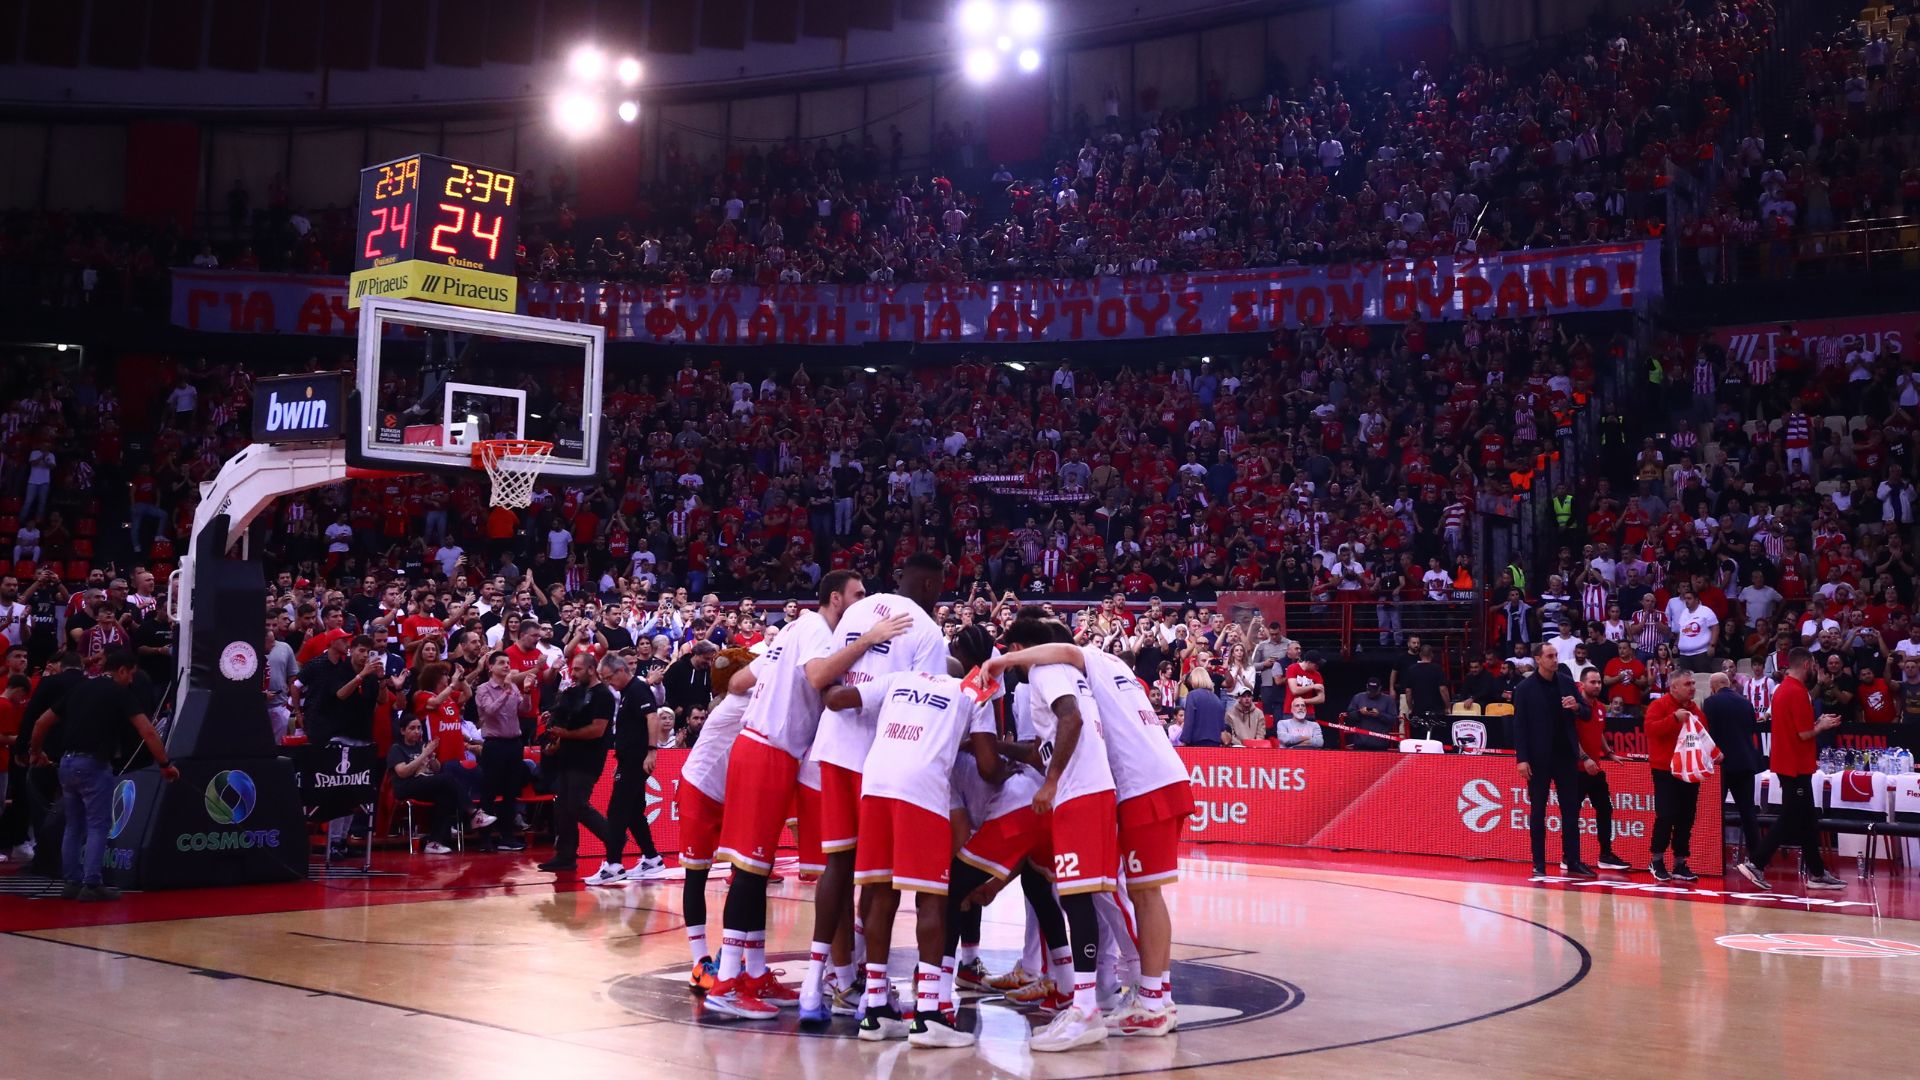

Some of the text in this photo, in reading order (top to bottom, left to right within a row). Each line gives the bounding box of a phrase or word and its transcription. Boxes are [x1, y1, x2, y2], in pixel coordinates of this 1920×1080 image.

[376, 159, 419, 200] 2:39
[445, 164, 515, 206] 2:39
[365, 203, 411, 258] 24
[430, 203, 502, 260] 24
[448, 256, 484, 270] Quince
[369, 275, 409, 295] Piraeus
[444, 277, 509, 302] Piraeus
[984, 291, 1203, 340] ΑΥΤΟΥΣ
[266, 387, 327, 431] bwin
[892, 688, 951, 710] FMS
[885, 722, 924, 741] PIRAEUS
[314, 769, 371, 788] SPALDING
[1189, 764, 1306, 791] AIRLINES
[176, 829, 281, 852] COSMOTE
[1054, 852, 1080, 878] 22
[1128, 850, 1143, 873] 6
